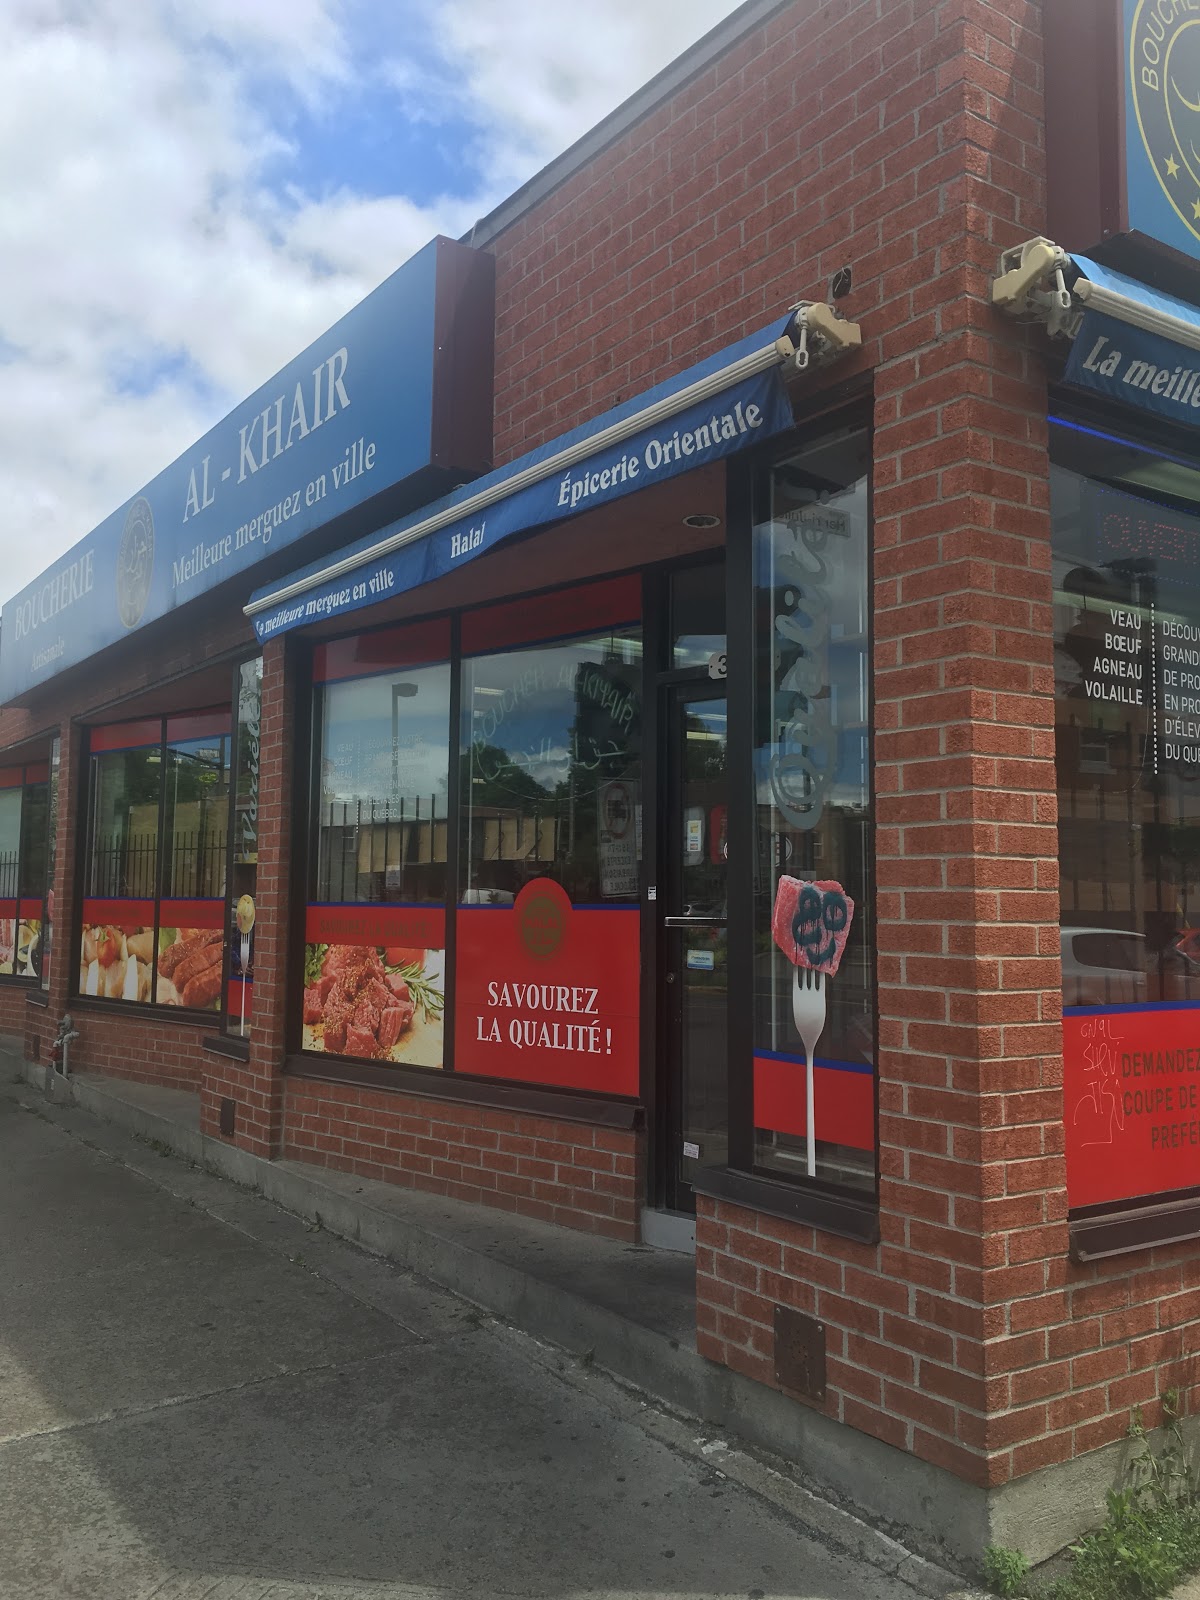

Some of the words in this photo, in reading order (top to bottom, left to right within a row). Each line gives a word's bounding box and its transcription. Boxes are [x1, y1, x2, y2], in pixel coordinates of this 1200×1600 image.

[1082, 335, 1122, 378] La
[182, 454, 216, 523] AL
[237, 346, 352, 485] KHAIR
[557, 455, 640, 508] Épicerie
[645, 400, 764, 471] Orientale
[172, 534, 232, 589] Meilleure
[235, 489, 301, 544] merguez
[305, 473, 327, 508] en
[331, 436, 376, 490] ville
[450, 521, 487, 559] Halal
[15, 548, 95, 641] BOUCHERIE
[265, 604, 305, 634] meilleure
[305, 588, 350, 616] merguez
[352, 583, 367, 601] en
[368, 567, 396, 595] ville
[1110, 608, 1142, 630] VEAU
[31, 635, 65, 673] Artisanale
[1105, 632, 1142, 655] BŒUF
[1163, 644, 1200, 666] GRAND
[1093, 656, 1143, 680] AGNEAU
[1163, 668, 1178, 687] DE
[1085, 680, 1143, 706] VOLAILLE
[1164, 693, 1179, 711] EN
[1165, 743, 1180, 760] DU
[487, 980, 599, 1015] SAVOUREZ
[476, 1016, 503, 1043] LA
[1123, 1087, 1173, 1116] COUPE
[1179, 1084, 1198, 1110] DE
[1151, 1114, 1200, 1151] PREFÉ
